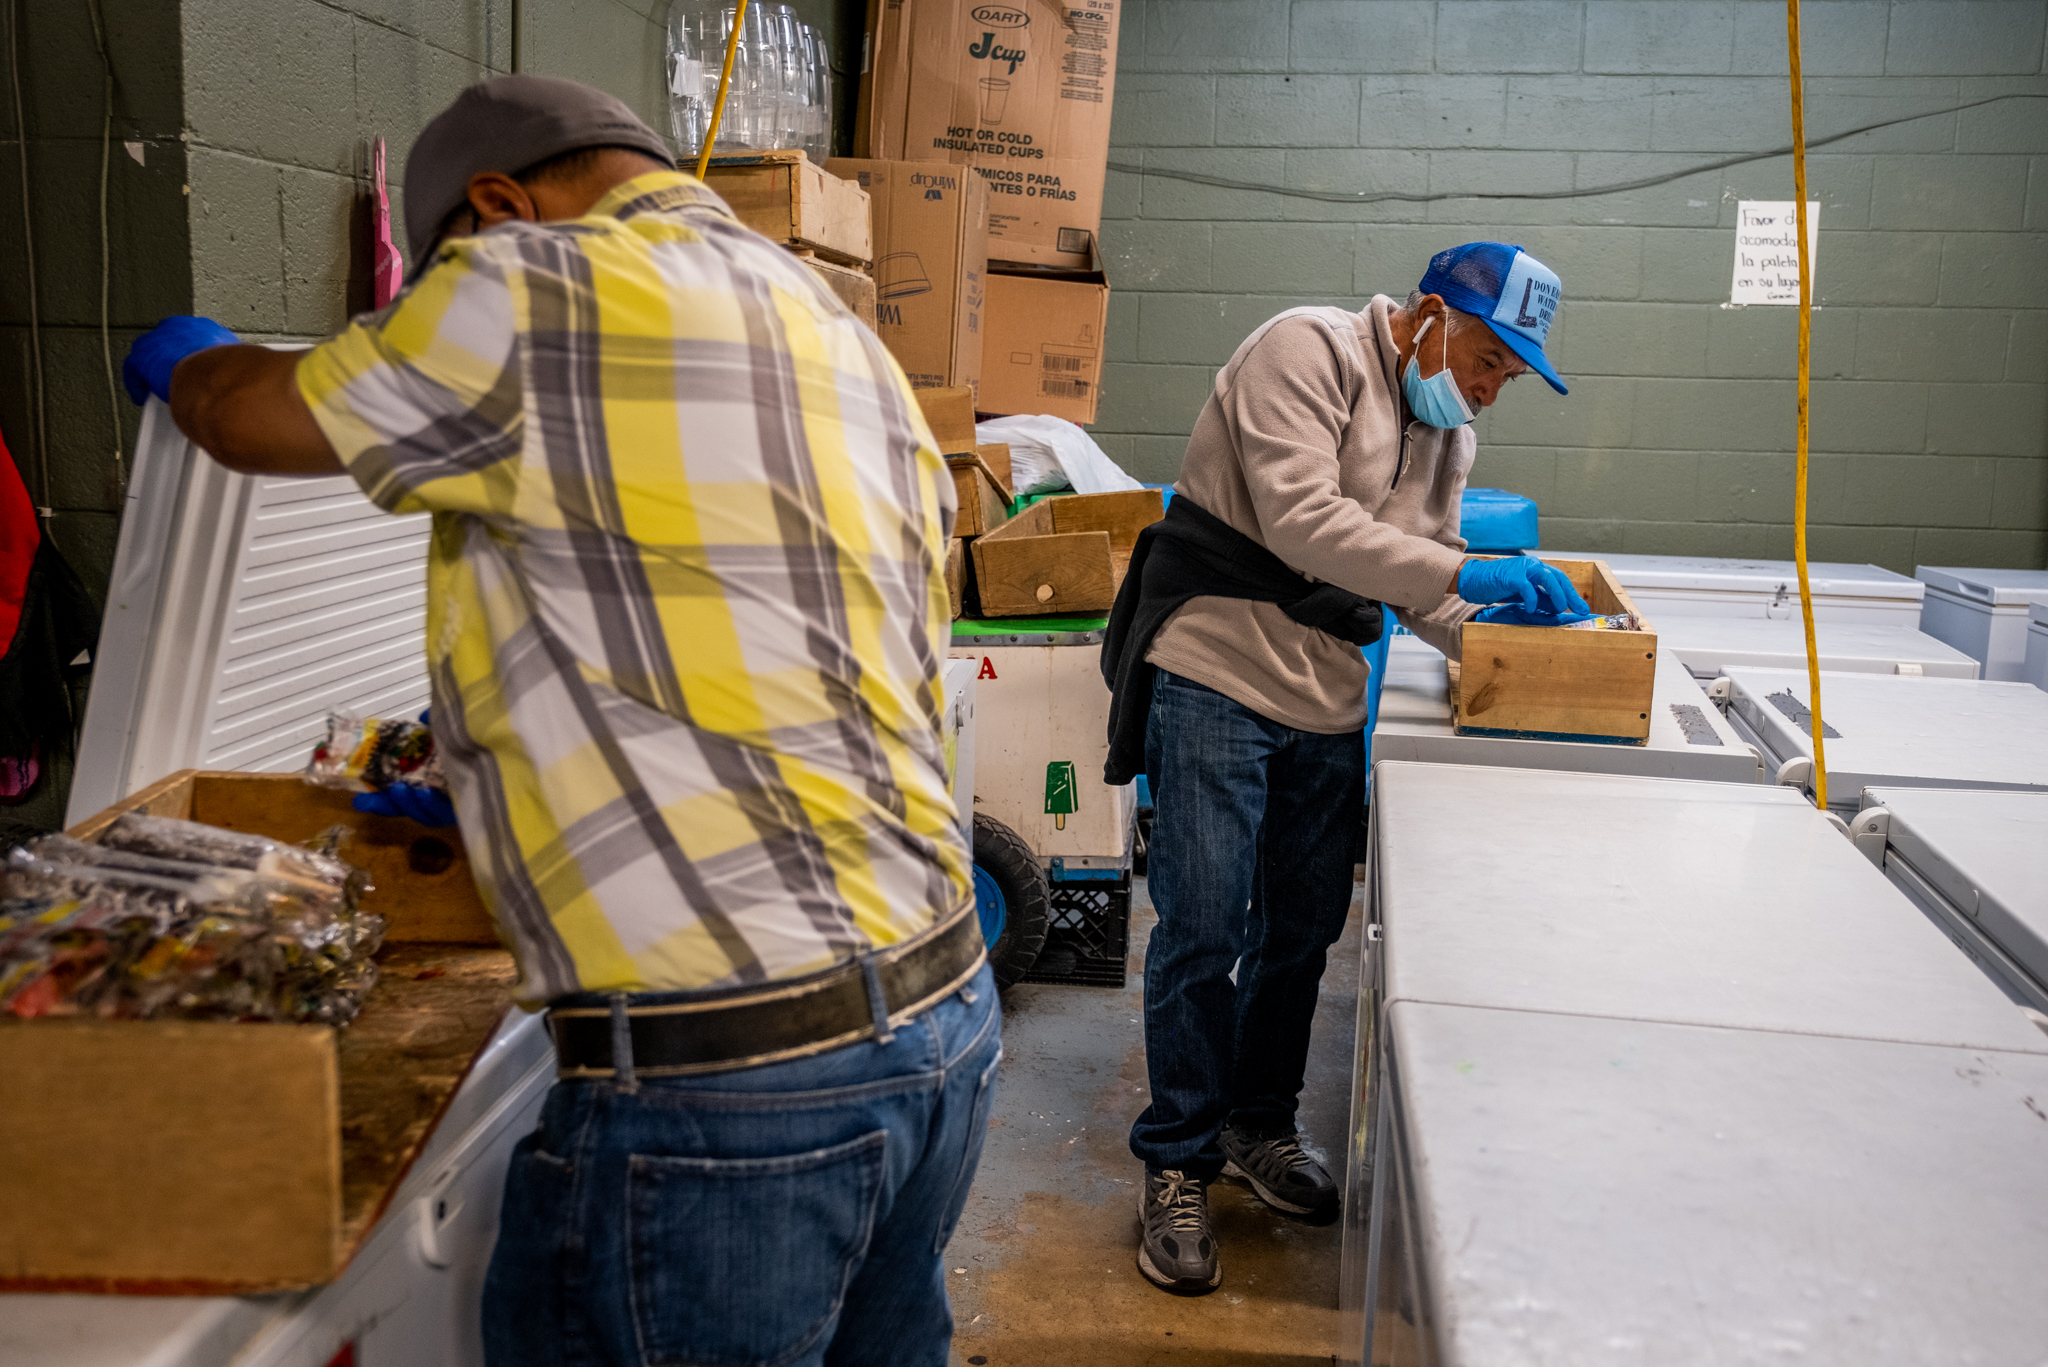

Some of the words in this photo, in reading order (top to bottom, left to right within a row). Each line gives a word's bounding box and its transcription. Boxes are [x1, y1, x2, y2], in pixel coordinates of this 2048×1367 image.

[978, 10, 1023, 24] DART
[947, 126, 973, 138] HOT
[976, 129, 994, 141] OR
[997, 131, 1033, 145] COLD
[933, 138, 1005, 155] INSULATED
[1008, 146, 1044, 159] CUPS
[910, 172, 956, 190] WinCup
[1026, 173, 1061, 187] PARA
[1026, 186, 1036, 196] O
[1039, 187, 1077, 201] FRÍAS
[1743, 209, 1776, 227] Favor
[1784, 209, 1797, 226] d
[1739, 232, 1798, 247] acomoda
[1741, 252, 1754, 267] la
[1761, 254, 1798, 271] paleta
[1533, 280, 1551, 295] DON
[1738, 279, 1753, 288] en
[1760, 279, 1773, 288] su
[1777, 273, 1800, 291] luga
